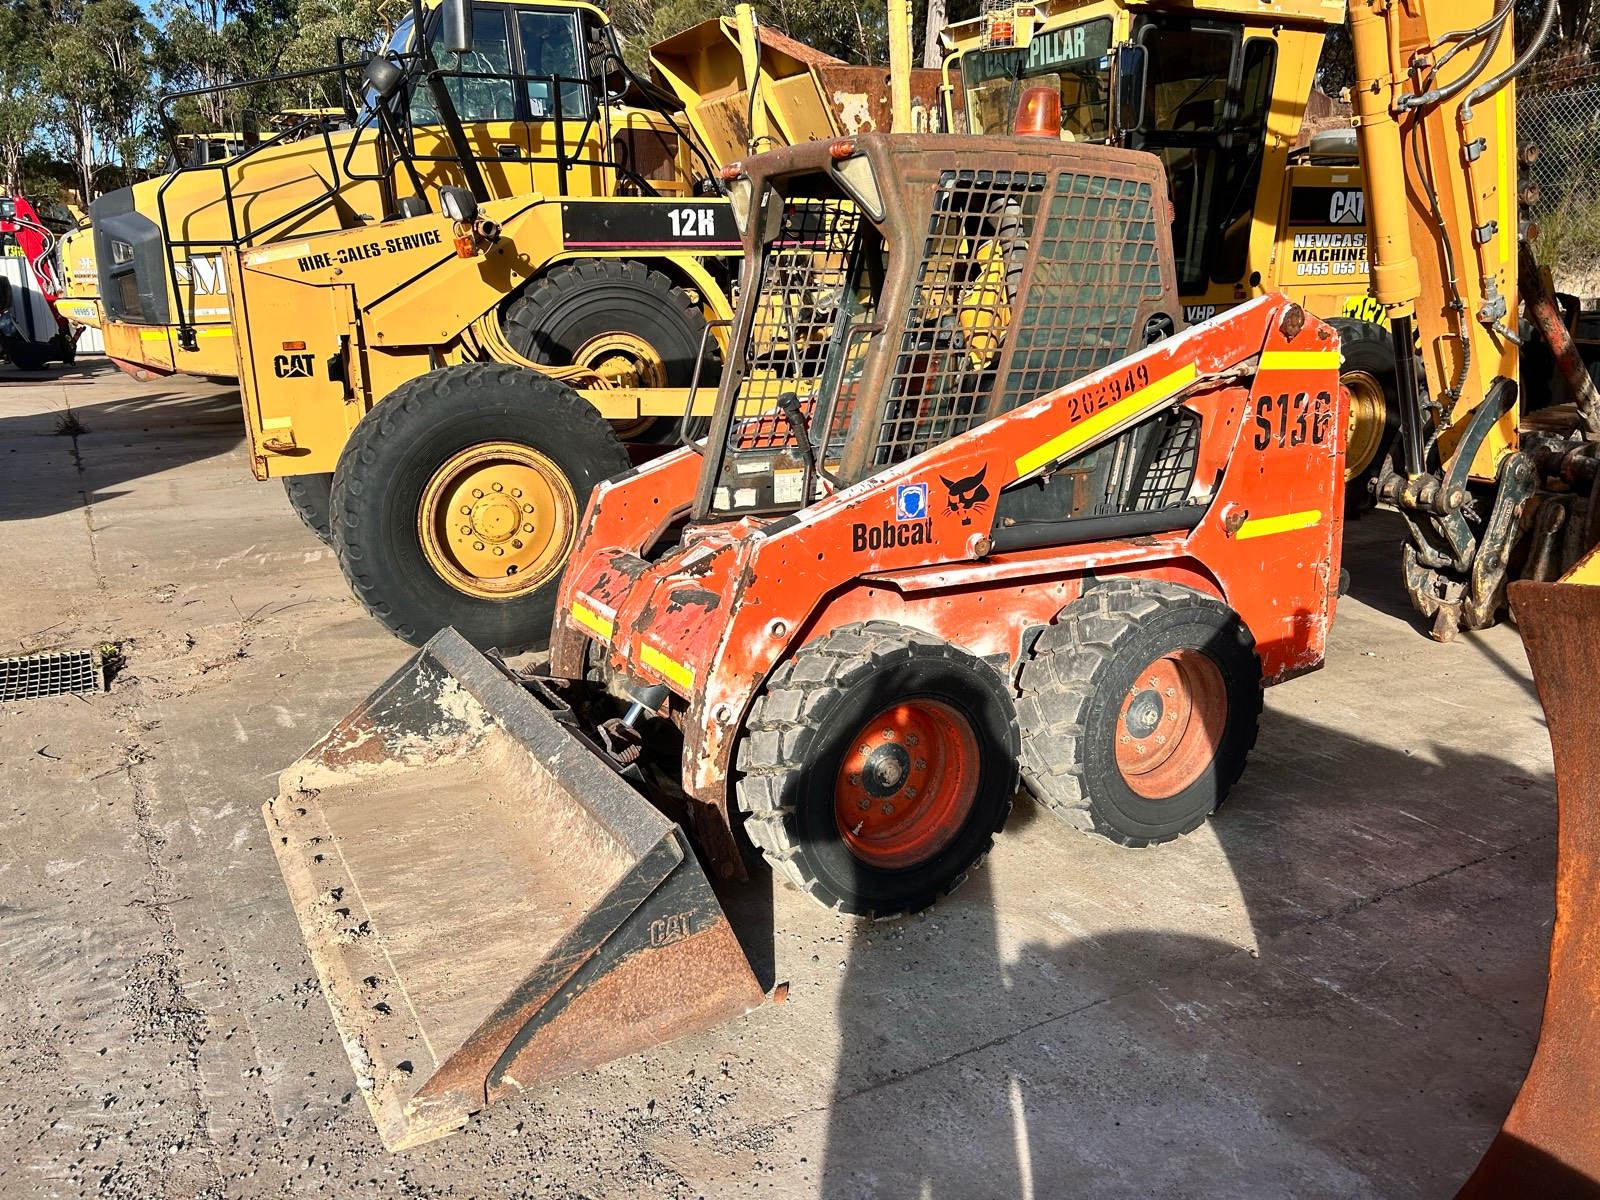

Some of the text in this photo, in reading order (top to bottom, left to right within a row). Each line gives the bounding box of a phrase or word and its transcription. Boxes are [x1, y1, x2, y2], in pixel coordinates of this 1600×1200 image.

[1329, 190, 1364, 223] CAT
[667, 208, 715, 236] 12H
[297, 230, 442, 272] HIRE-SALES-SERVICE
[1292, 248, 1368, 262] MACHINE
[1296, 262, 1329, 276] 0455
[1332, 262, 1356, 275] 055
[1187, 305, 1216, 322] VHP
[273, 353, 315, 378] CAT
[852, 517, 933, 553] Bobcat
[650, 911, 695, 947] CAT
